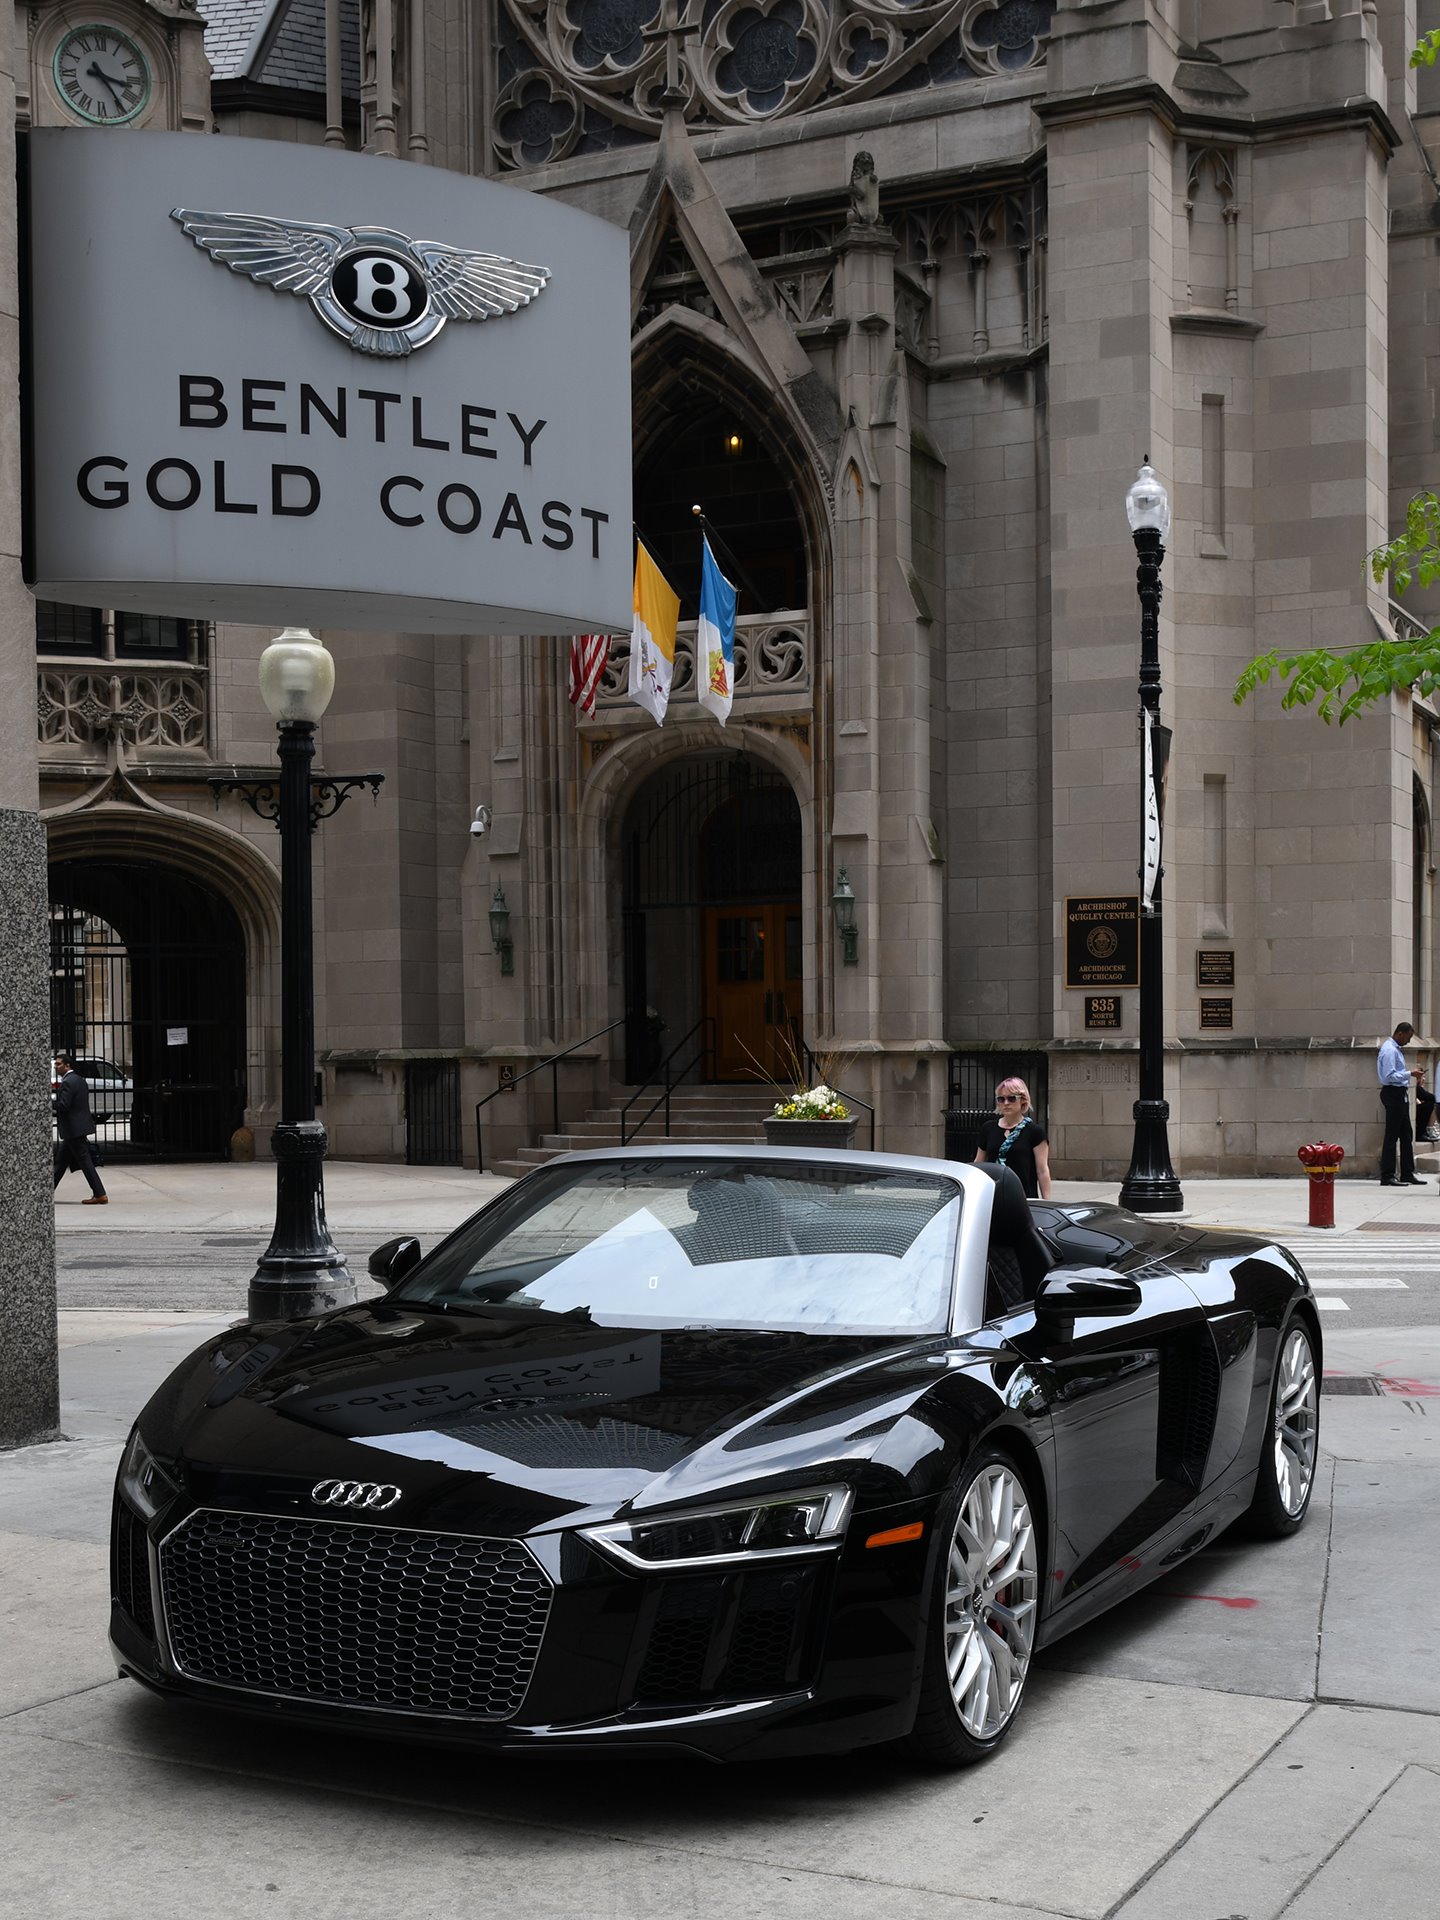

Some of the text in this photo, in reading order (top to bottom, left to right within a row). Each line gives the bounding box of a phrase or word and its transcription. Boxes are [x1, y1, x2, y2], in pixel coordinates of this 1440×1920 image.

[353, 257, 411, 320] B
[178, 374, 547, 467] BENTLEY
[77, 456, 609, 559] GOLD COAST
[1069, 911, 1135, 922] QUIGLEY CENTER
[1077, 902, 1127, 911] ARCHBISHOP
[1091, 998, 1115, 1012] 835
